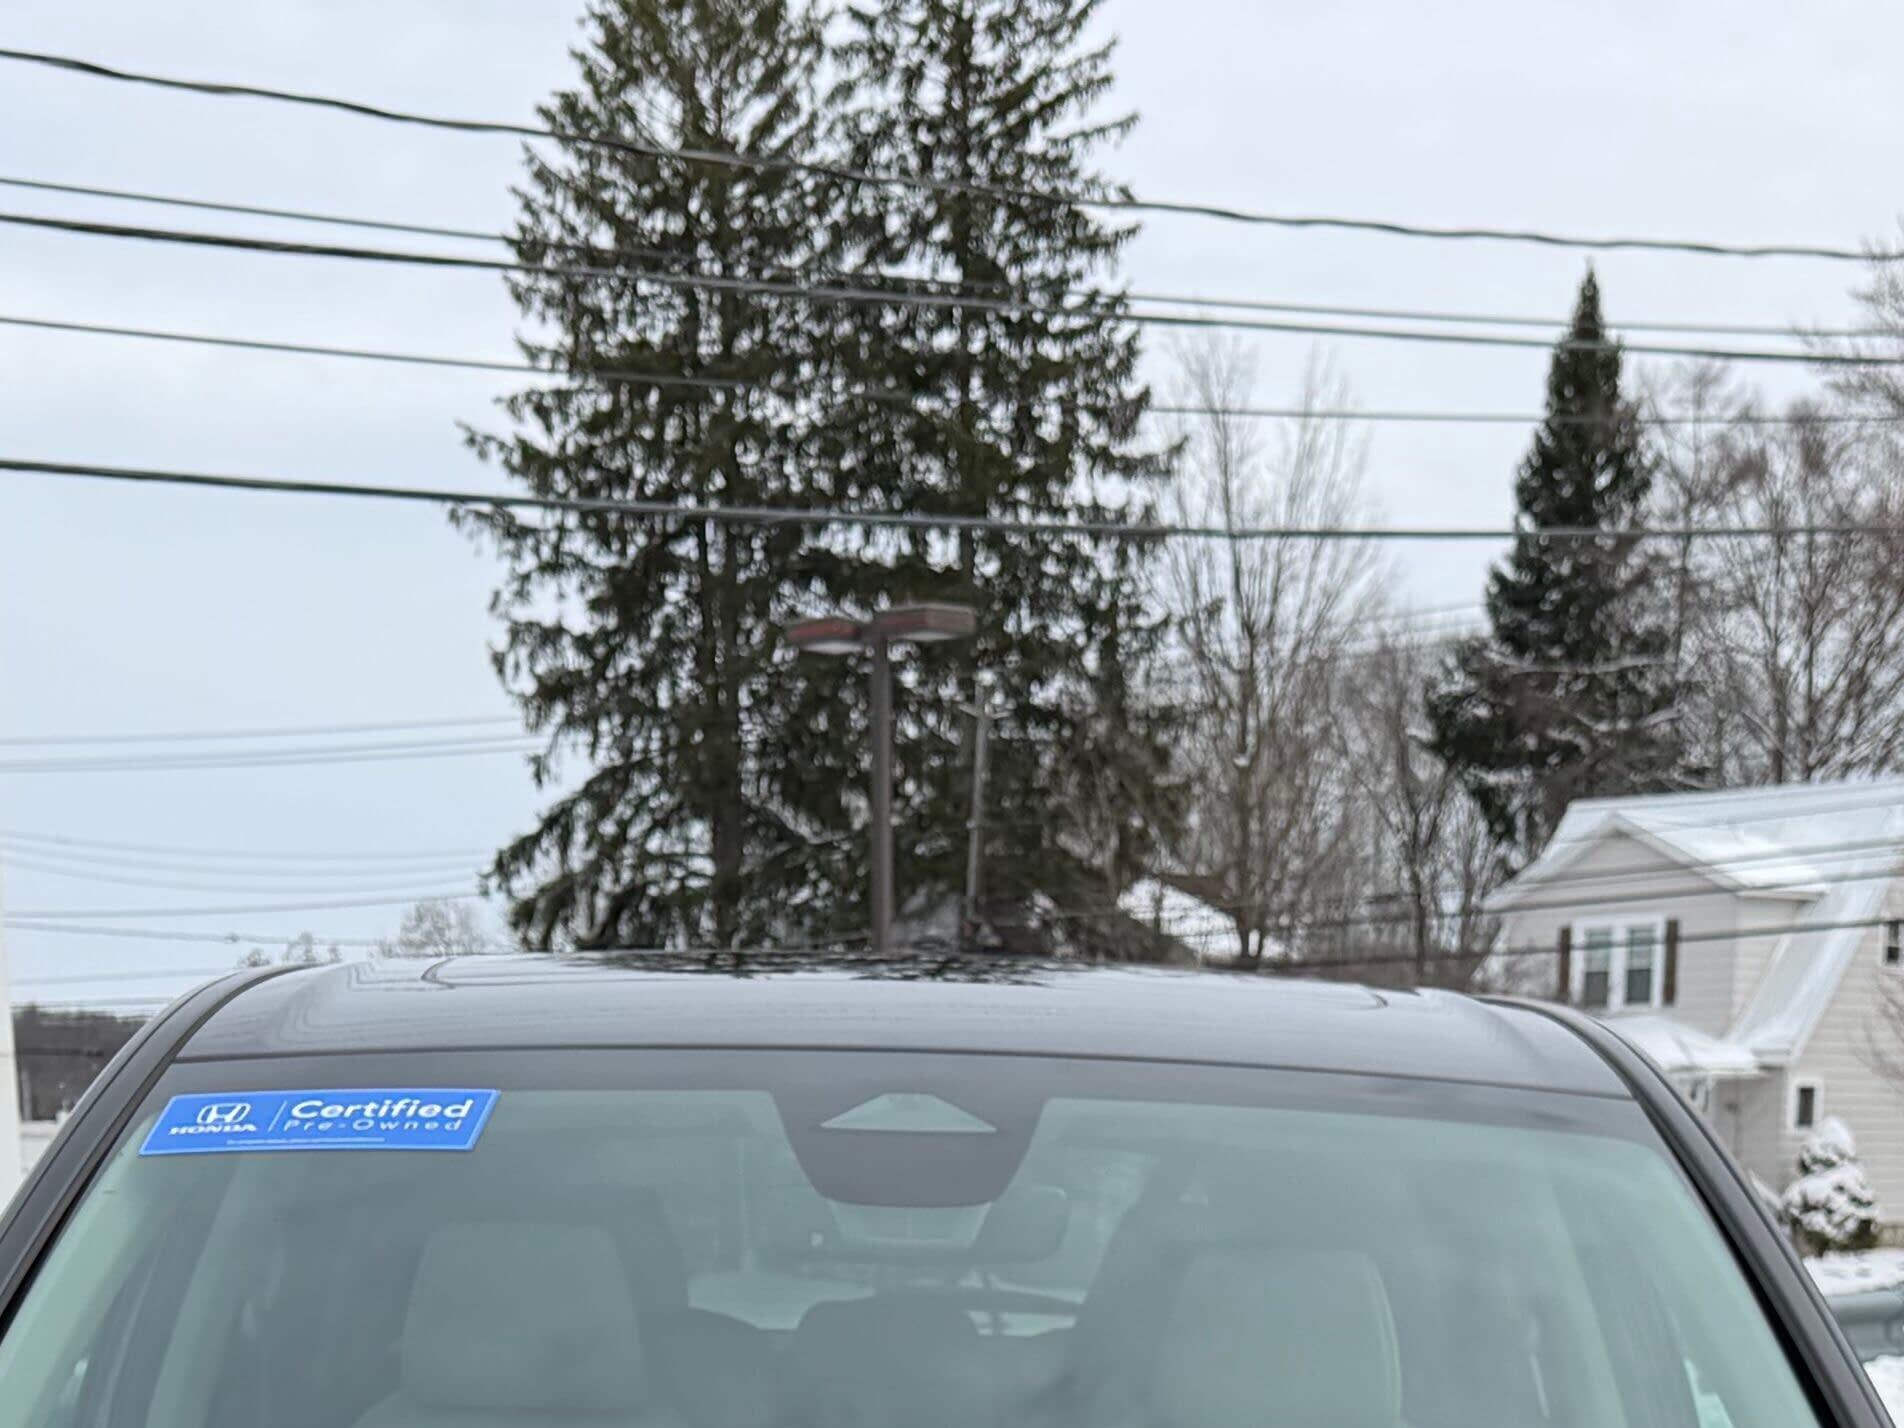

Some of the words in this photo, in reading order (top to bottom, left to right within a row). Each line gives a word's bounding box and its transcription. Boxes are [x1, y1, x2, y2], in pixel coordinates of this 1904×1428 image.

[290, 1098, 475, 1119] Certified
[168, 1123, 257, 1136] HONDA
[283, 1118, 463, 1132] Pre-Owned
